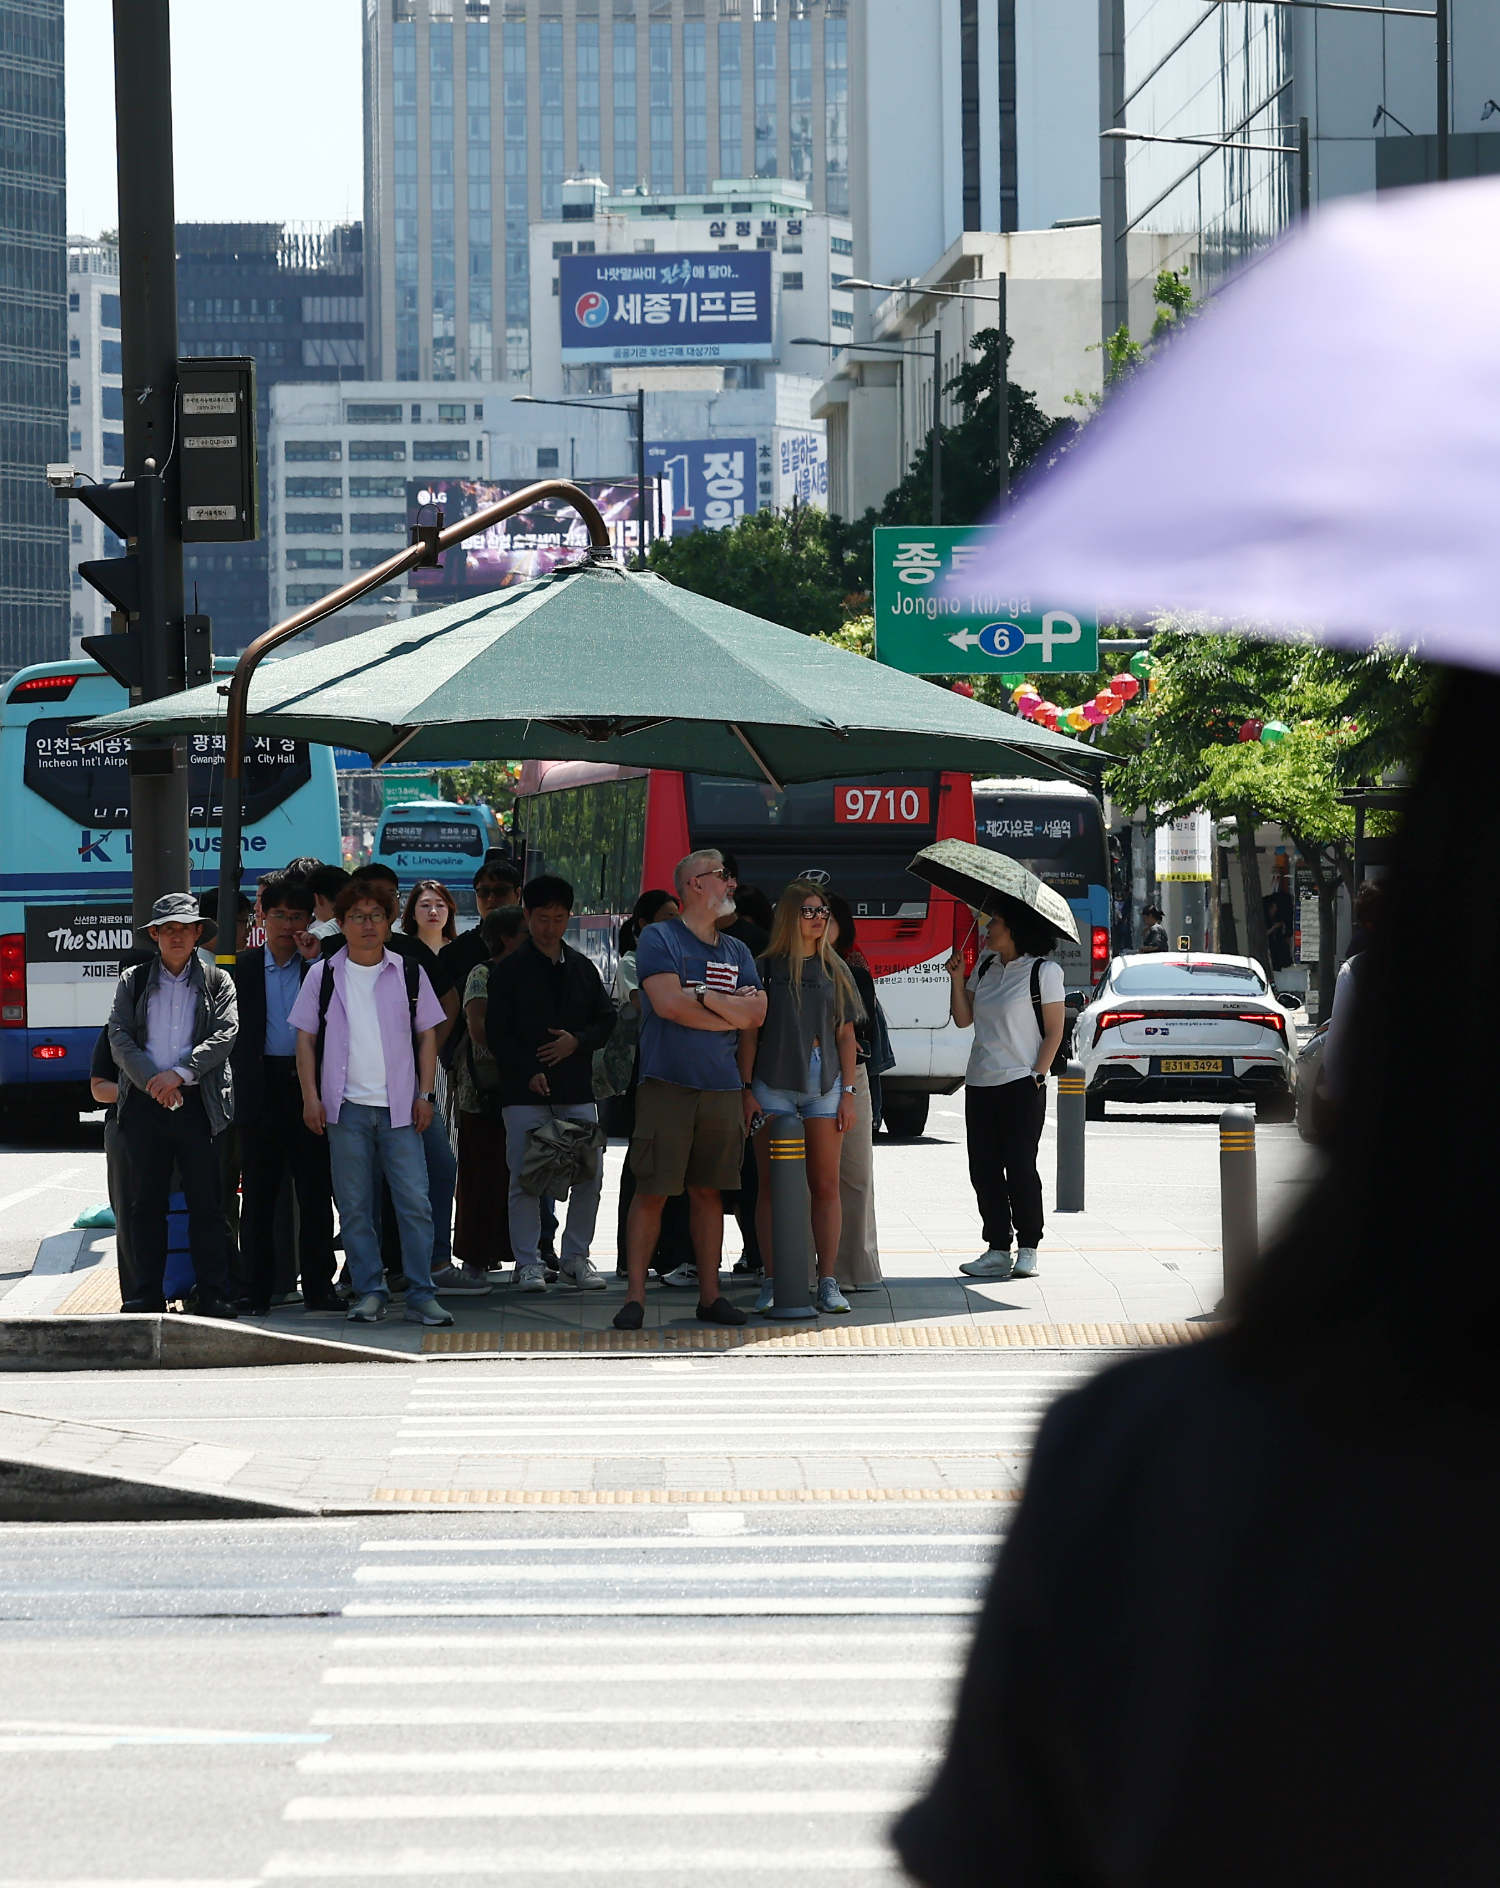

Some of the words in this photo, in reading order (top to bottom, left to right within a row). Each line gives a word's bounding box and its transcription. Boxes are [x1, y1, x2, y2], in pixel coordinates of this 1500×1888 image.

[709, 220, 803, 237] 삼정빌딩
[613, 291, 758, 325] 세종기프트
[613, 347, 647, 359] 공공기관
[650, 346, 684, 357] 우선구매
[431, 491, 447, 504] LG
[891, 591, 962, 620] Jongno
[993, 629, 1010, 651] 6
[192, 734, 227, 751] 광화
[38, 758, 78, 768] Incheon
[81, 755, 101, 767] Int'l
[257, 754, 275, 766] City
[277, 753, 295, 764] Hall
[845, 789, 920, 820] 9710
[985, 820, 1034, 838] 제2자유로
[1042, 819, 1071, 838] 서울역
[412, 855, 464, 866] Limousine
[73, 915, 98, 925] 신선한
[99, 915, 123, 925] 재료와
[124, 915, 133, 924] 매
[47, 927, 86, 953] The
[82, 964, 118, 978] 지미존
[874, 964, 909, 975] 합자회사
[907, 976, 950, 984] 031-943-0713
[1193, 1061, 1219, 1071] 3494
